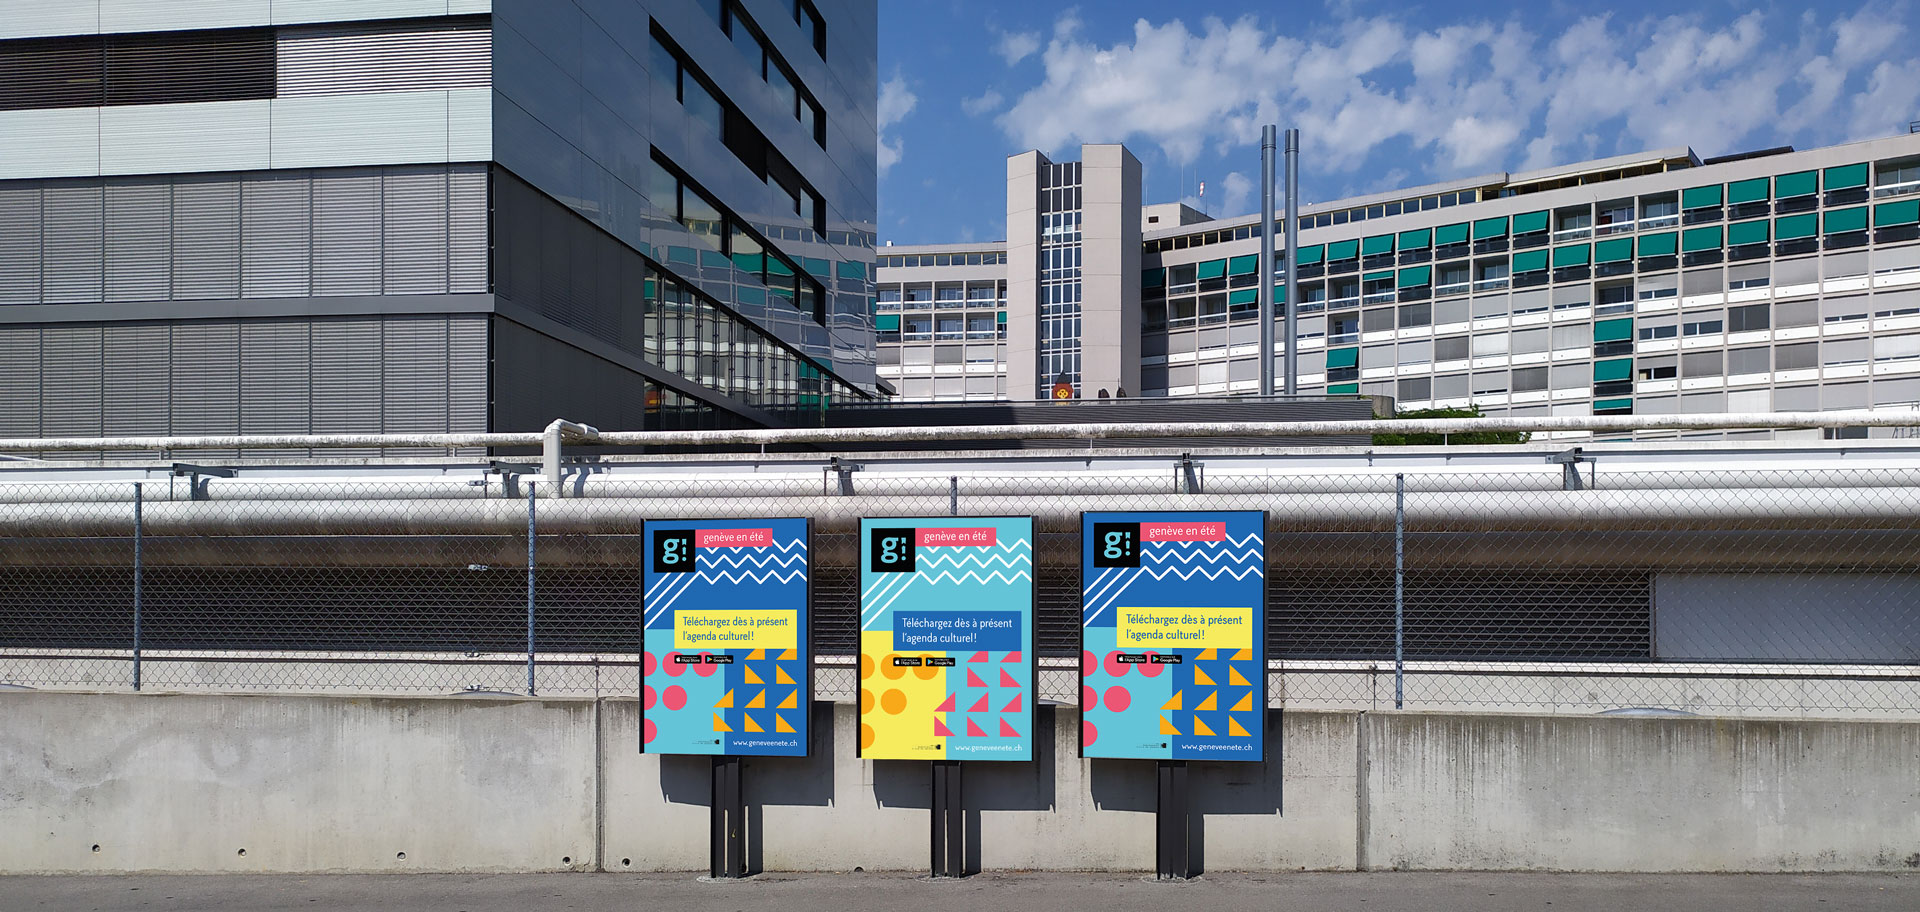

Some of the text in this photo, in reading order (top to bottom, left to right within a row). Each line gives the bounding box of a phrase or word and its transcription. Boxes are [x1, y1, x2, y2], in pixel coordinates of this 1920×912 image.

[703, 531, 764, 545] genève en été
[924, 530, 987, 544] genève en été
[1149, 525, 1216, 538] genève en été
[682, 616, 788, 629] Téléchargez dès à présent
[901, 617, 1013, 631] Téléchargez dès à présent
[1125, 613, 1243, 627] Téléchargez dès à présent
[733, 739, 798, 748] www.geneveenete.ch
[954, 744, 1023, 753] www.geneveenete.ch
[1181, 743, 1253, 752] www.geneveenete.ch
